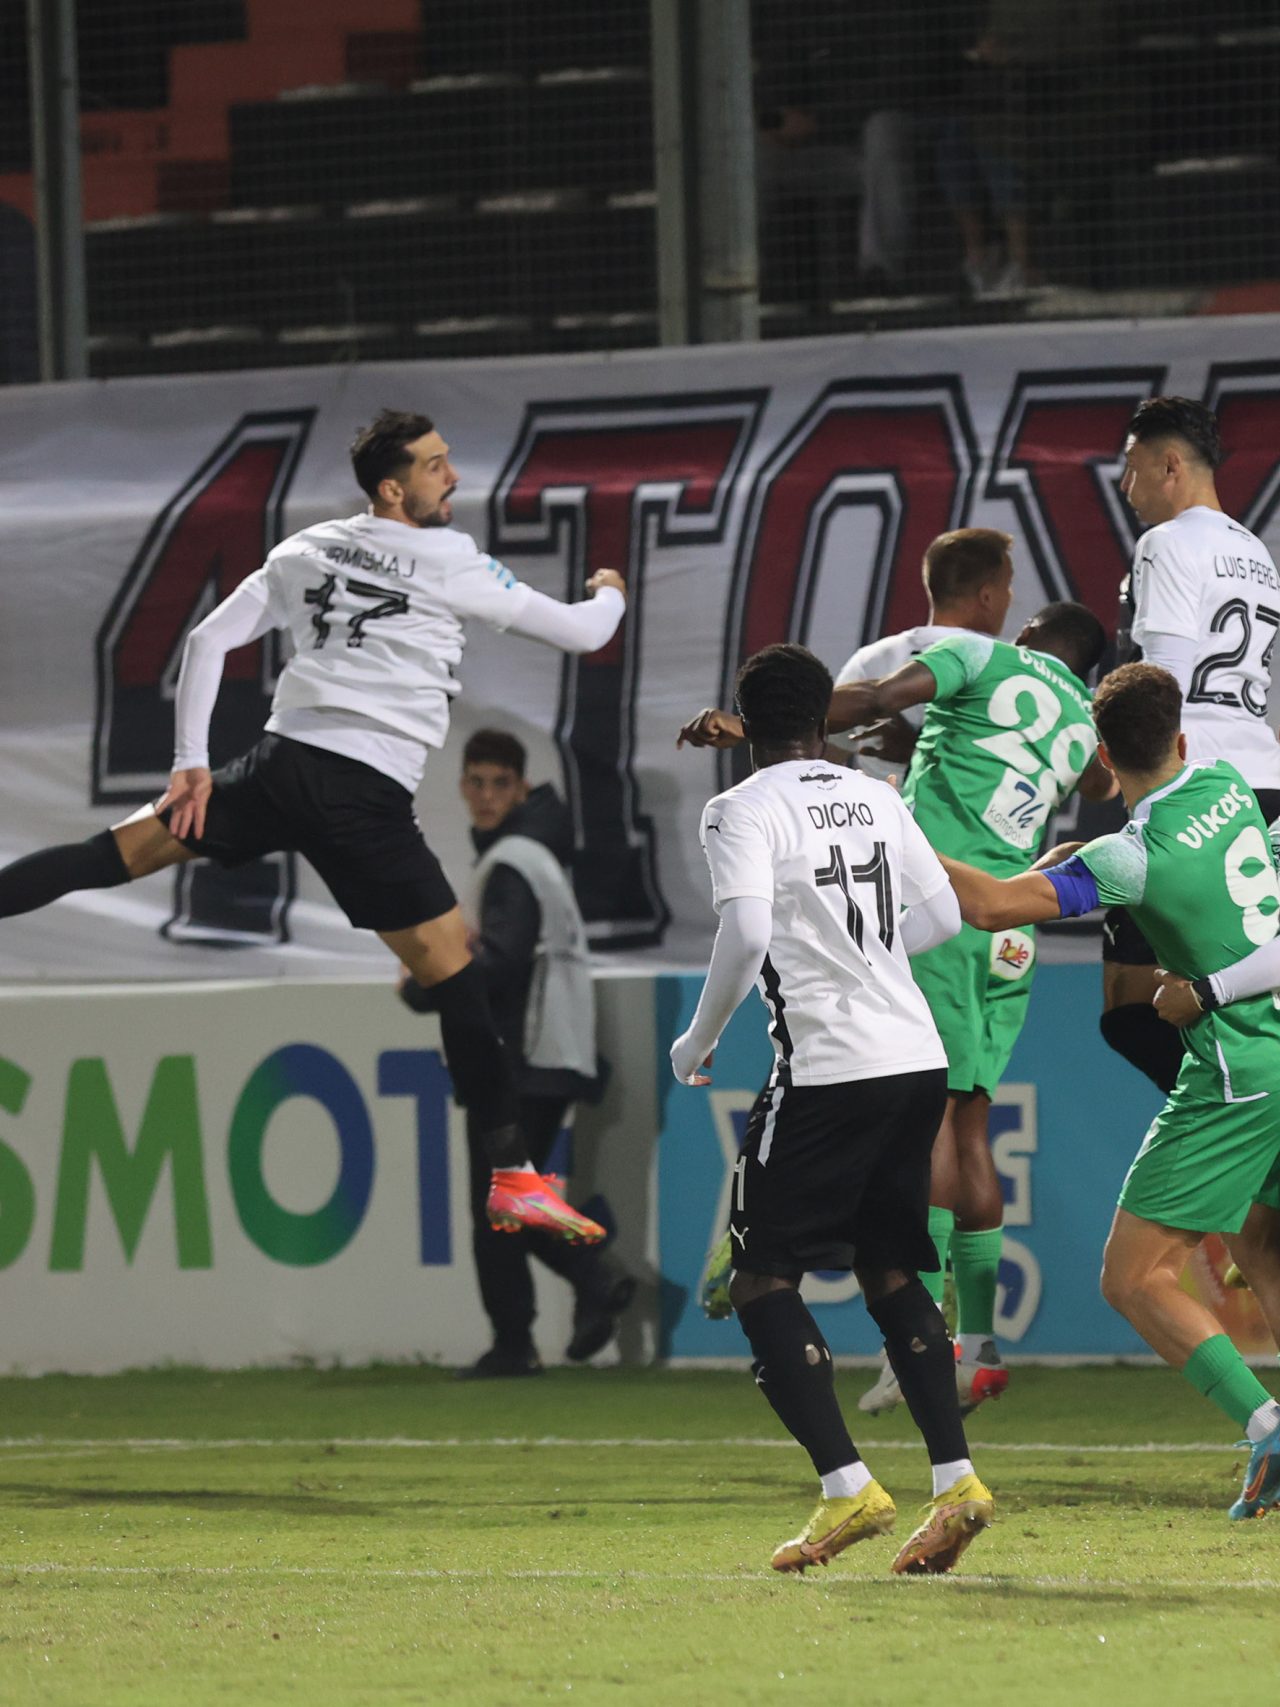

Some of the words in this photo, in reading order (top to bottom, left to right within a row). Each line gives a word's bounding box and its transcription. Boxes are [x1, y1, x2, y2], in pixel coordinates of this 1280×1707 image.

[1214, 555, 1247, 580] LUIS
[304, 572, 409, 649] 17
[807, 802, 874, 830] DICKO
[814, 841, 894, 966] 11
[0, 1043, 570, 1268] MOT
